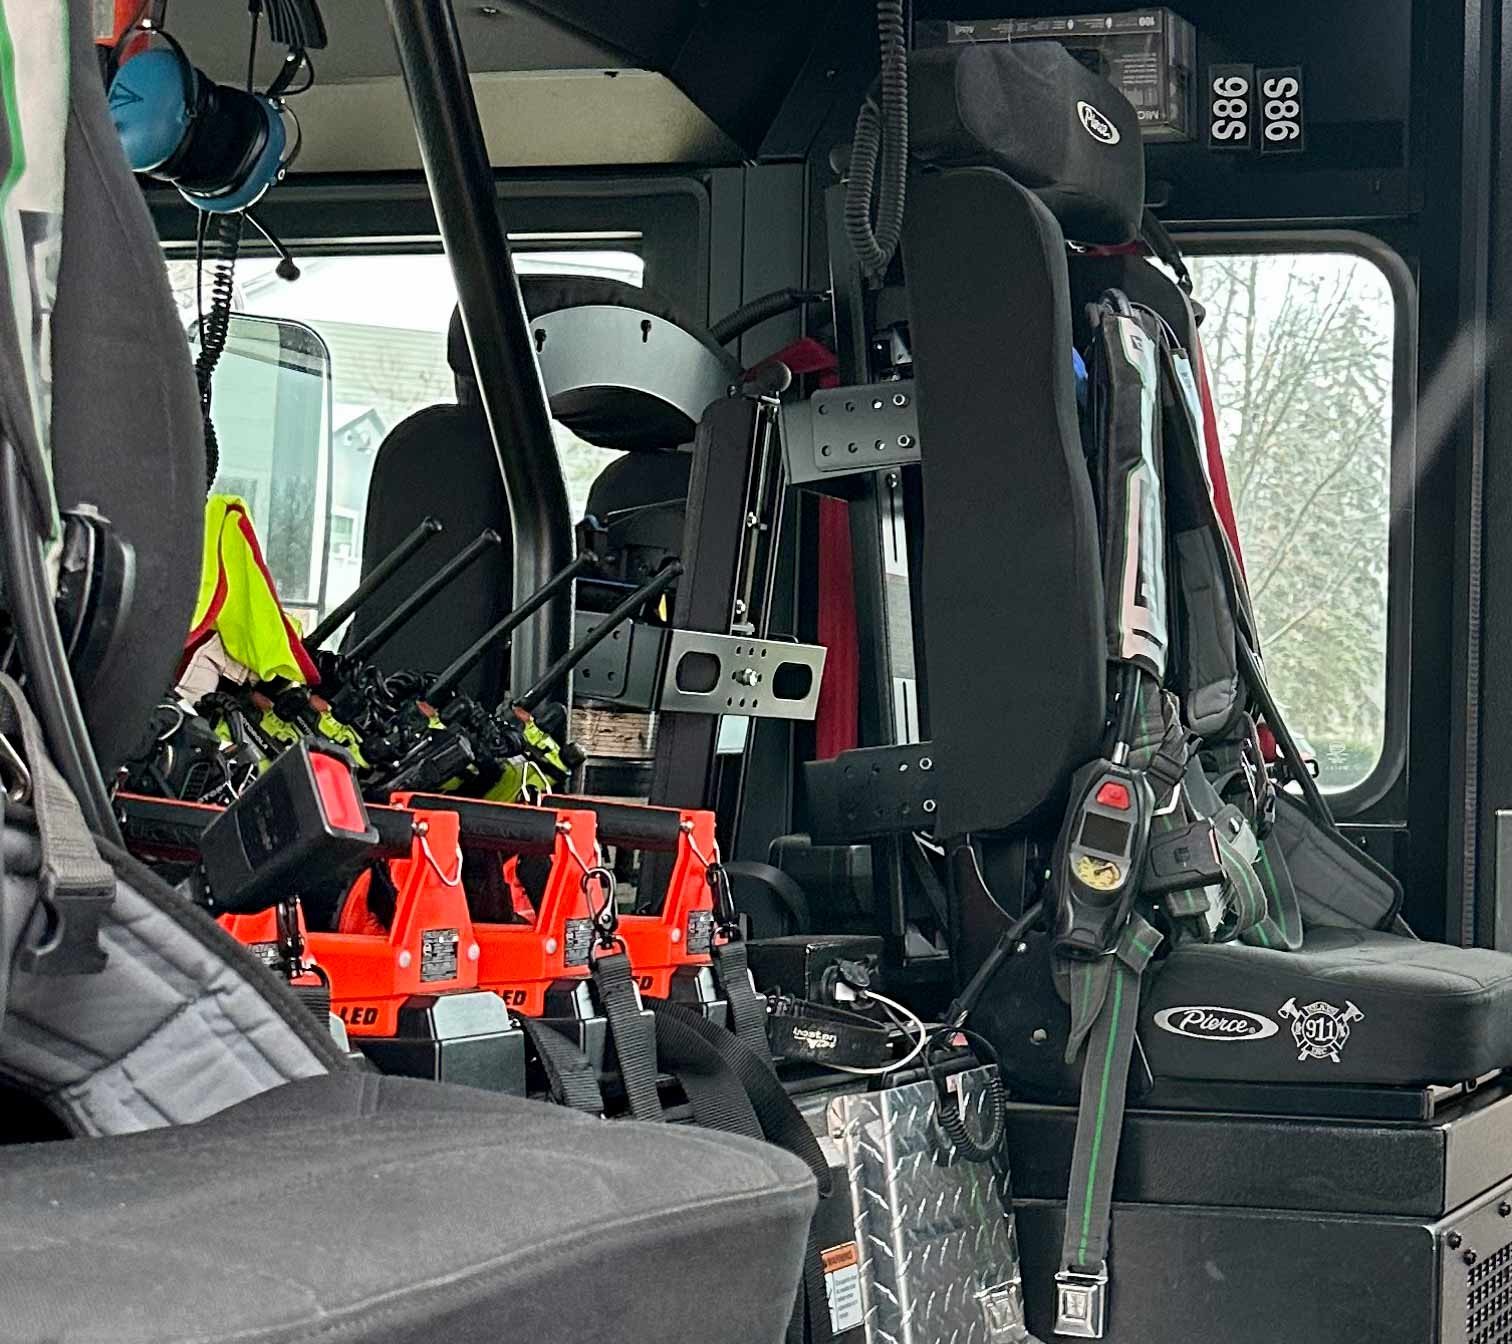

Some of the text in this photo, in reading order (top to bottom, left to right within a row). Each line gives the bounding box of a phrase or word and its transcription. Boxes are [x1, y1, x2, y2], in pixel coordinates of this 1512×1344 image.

[1136, 110, 1160, 120] MIC
[1212, 77, 1248, 140] S86
[1263, 77, 1299, 141] S86
[497, 990, 526, 1006] ED
[341, 1007, 378, 1025] LED
[1180, 1010, 1250, 1033] Pierce
[1305, 1017, 1335, 1042] 911
